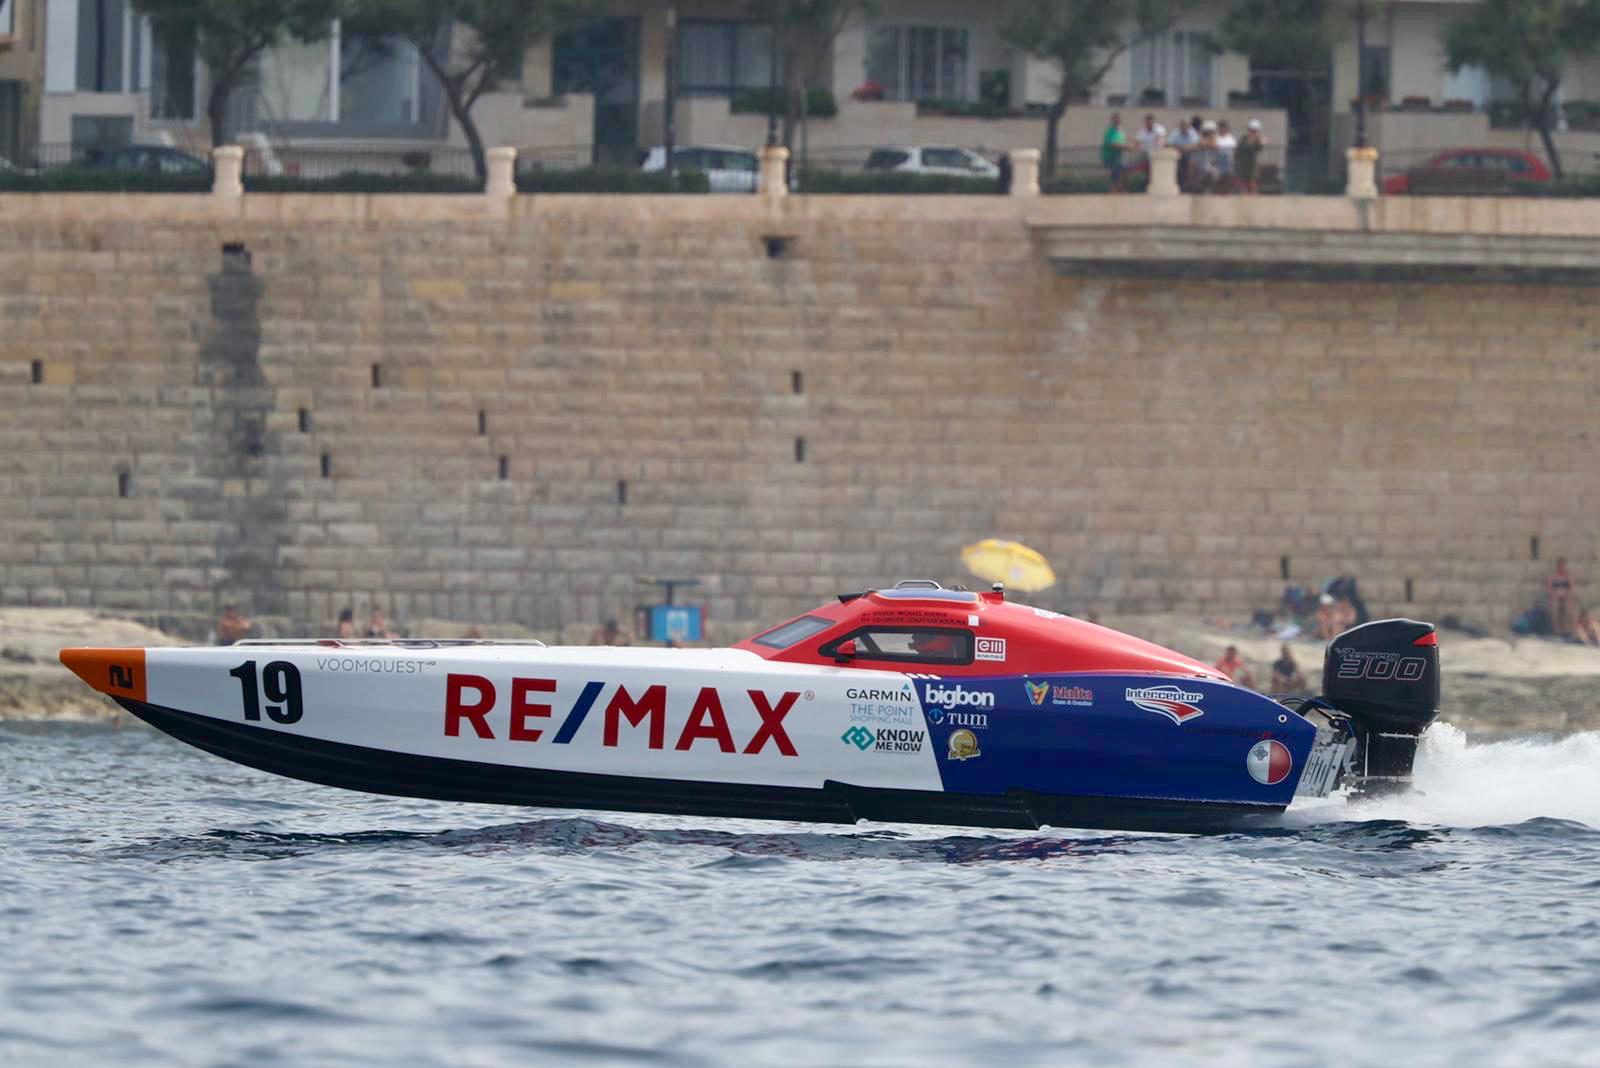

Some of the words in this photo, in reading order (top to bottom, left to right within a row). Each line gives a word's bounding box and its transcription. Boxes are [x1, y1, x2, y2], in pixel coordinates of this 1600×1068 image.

[317, 658, 425, 674] VOOMQUEST
[1337, 656, 1426, 681] 300
[229, 660, 304, 725] 19
[846, 688, 912, 702] GARMIN
[925, 683, 995, 709] bigbon
[1053, 686, 1093, 700] Malta
[1126, 688, 1204, 703] Interceptor
[444, 673, 801, 757] RE/MAX
[850, 703, 874, 715] THE
[878, 704, 914, 717] POINT
[876, 728, 925, 743] KNOW
[875, 742, 893, 751] ME
[894, 742, 922, 752] NOW
